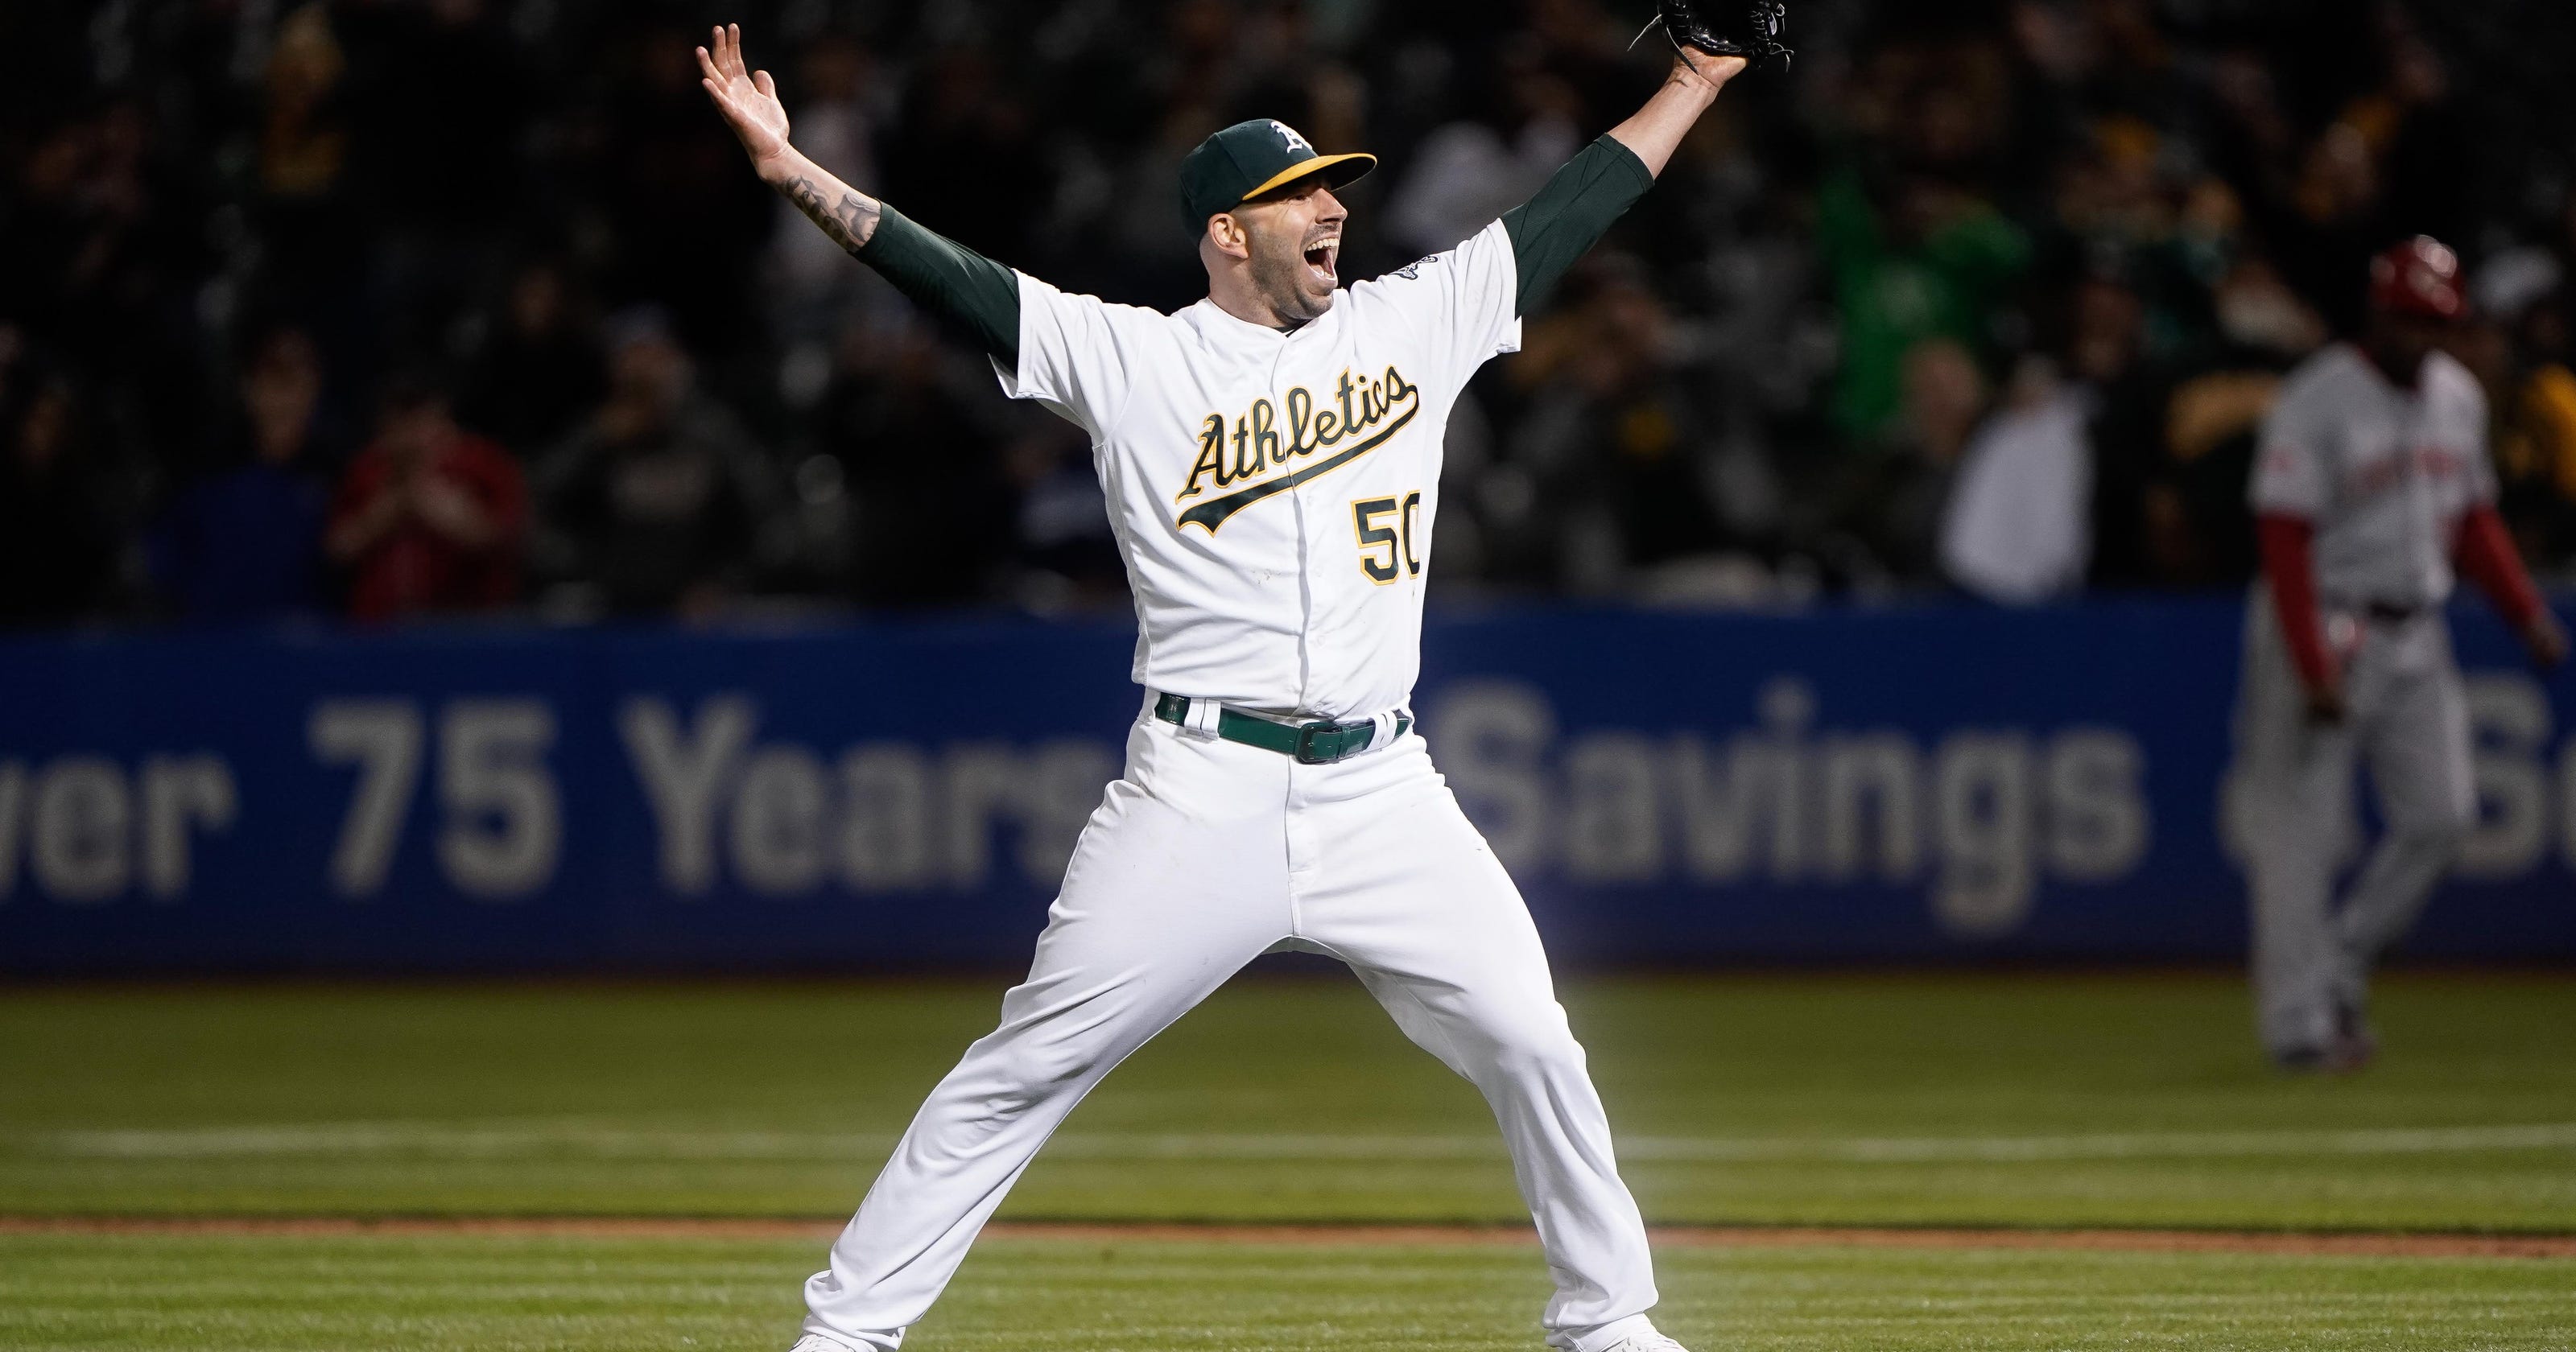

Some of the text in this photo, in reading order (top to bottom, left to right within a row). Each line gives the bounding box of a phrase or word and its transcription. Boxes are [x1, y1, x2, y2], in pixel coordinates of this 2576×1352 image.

[1175, 365, 1420, 505] Athletics
[306, 696, 561, 900] 75
[1435, 678, 2148, 931] Savings
